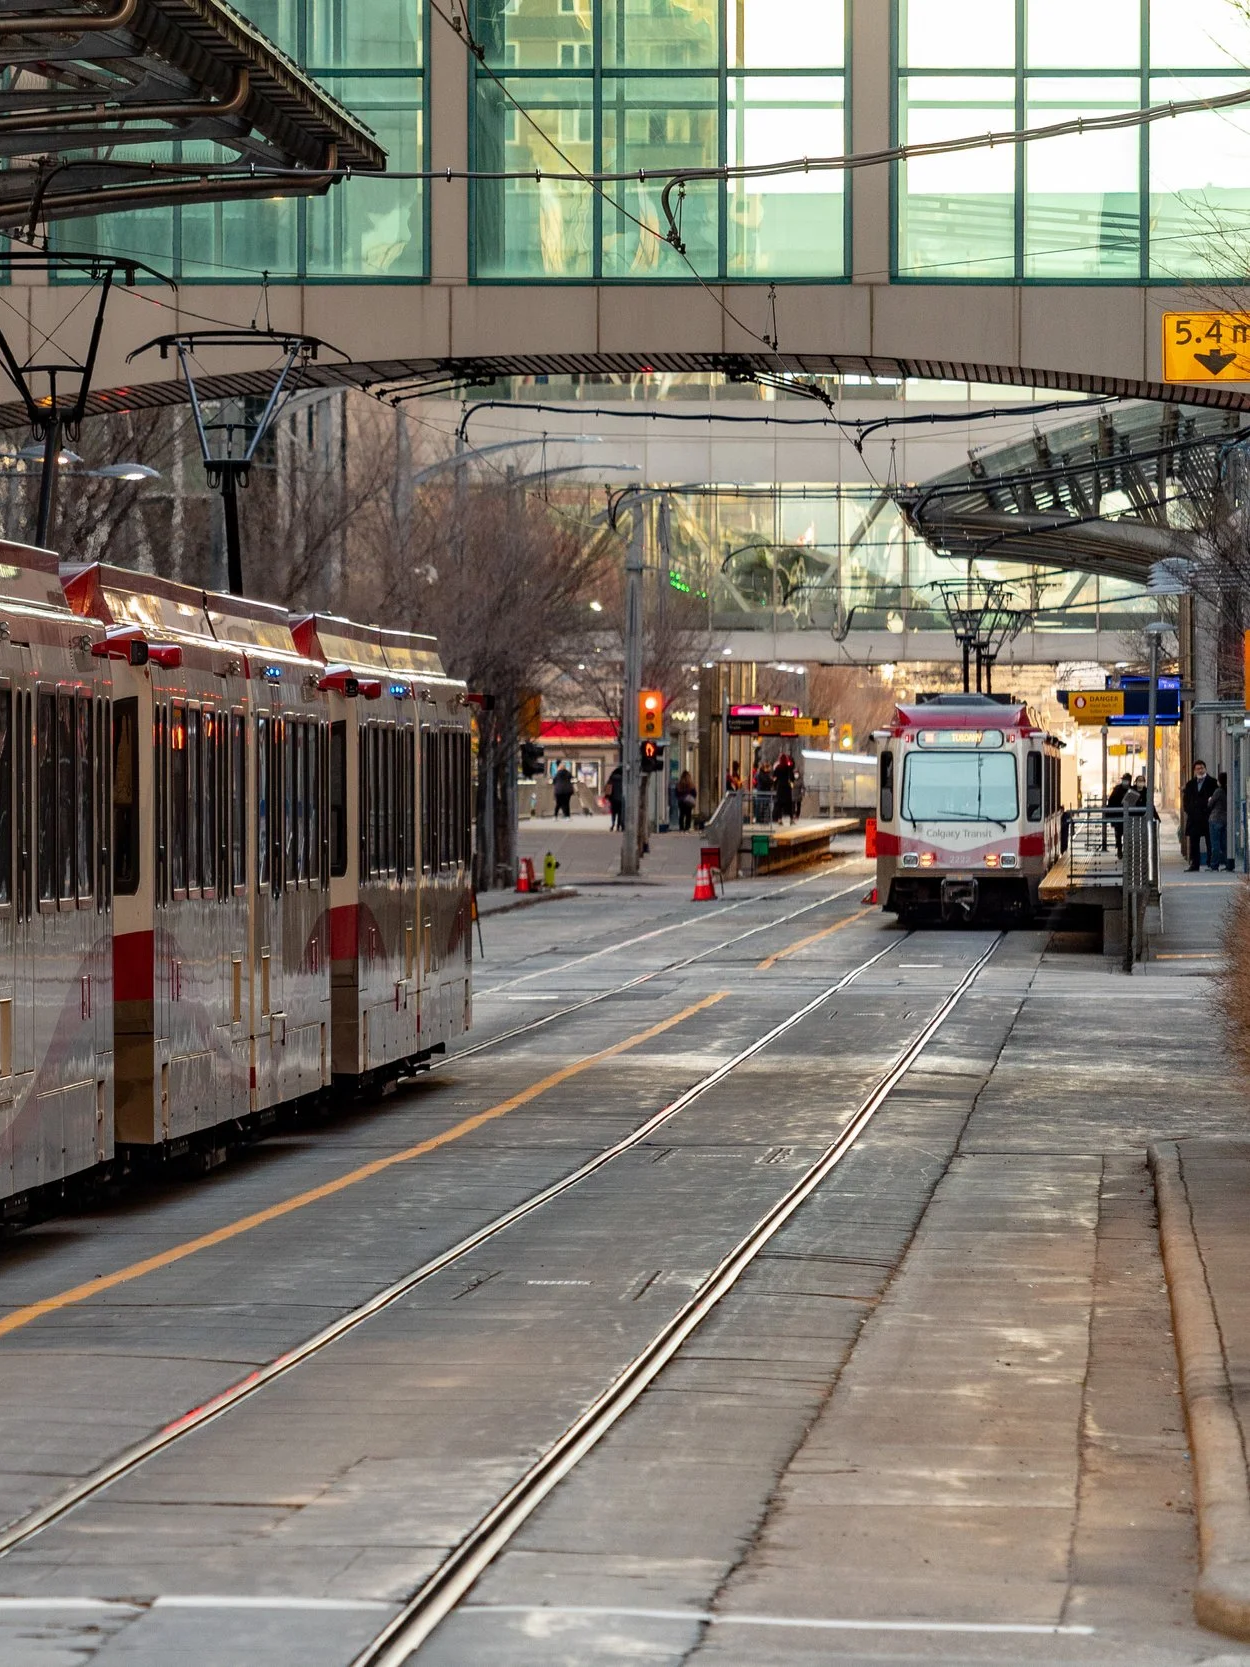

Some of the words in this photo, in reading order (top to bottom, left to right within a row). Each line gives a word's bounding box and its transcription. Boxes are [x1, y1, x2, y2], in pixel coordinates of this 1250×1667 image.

[1175, 319, 1223, 345] 5.4
[926, 829, 961, 840] Calgary
[963, 829, 992, 838] Transit
